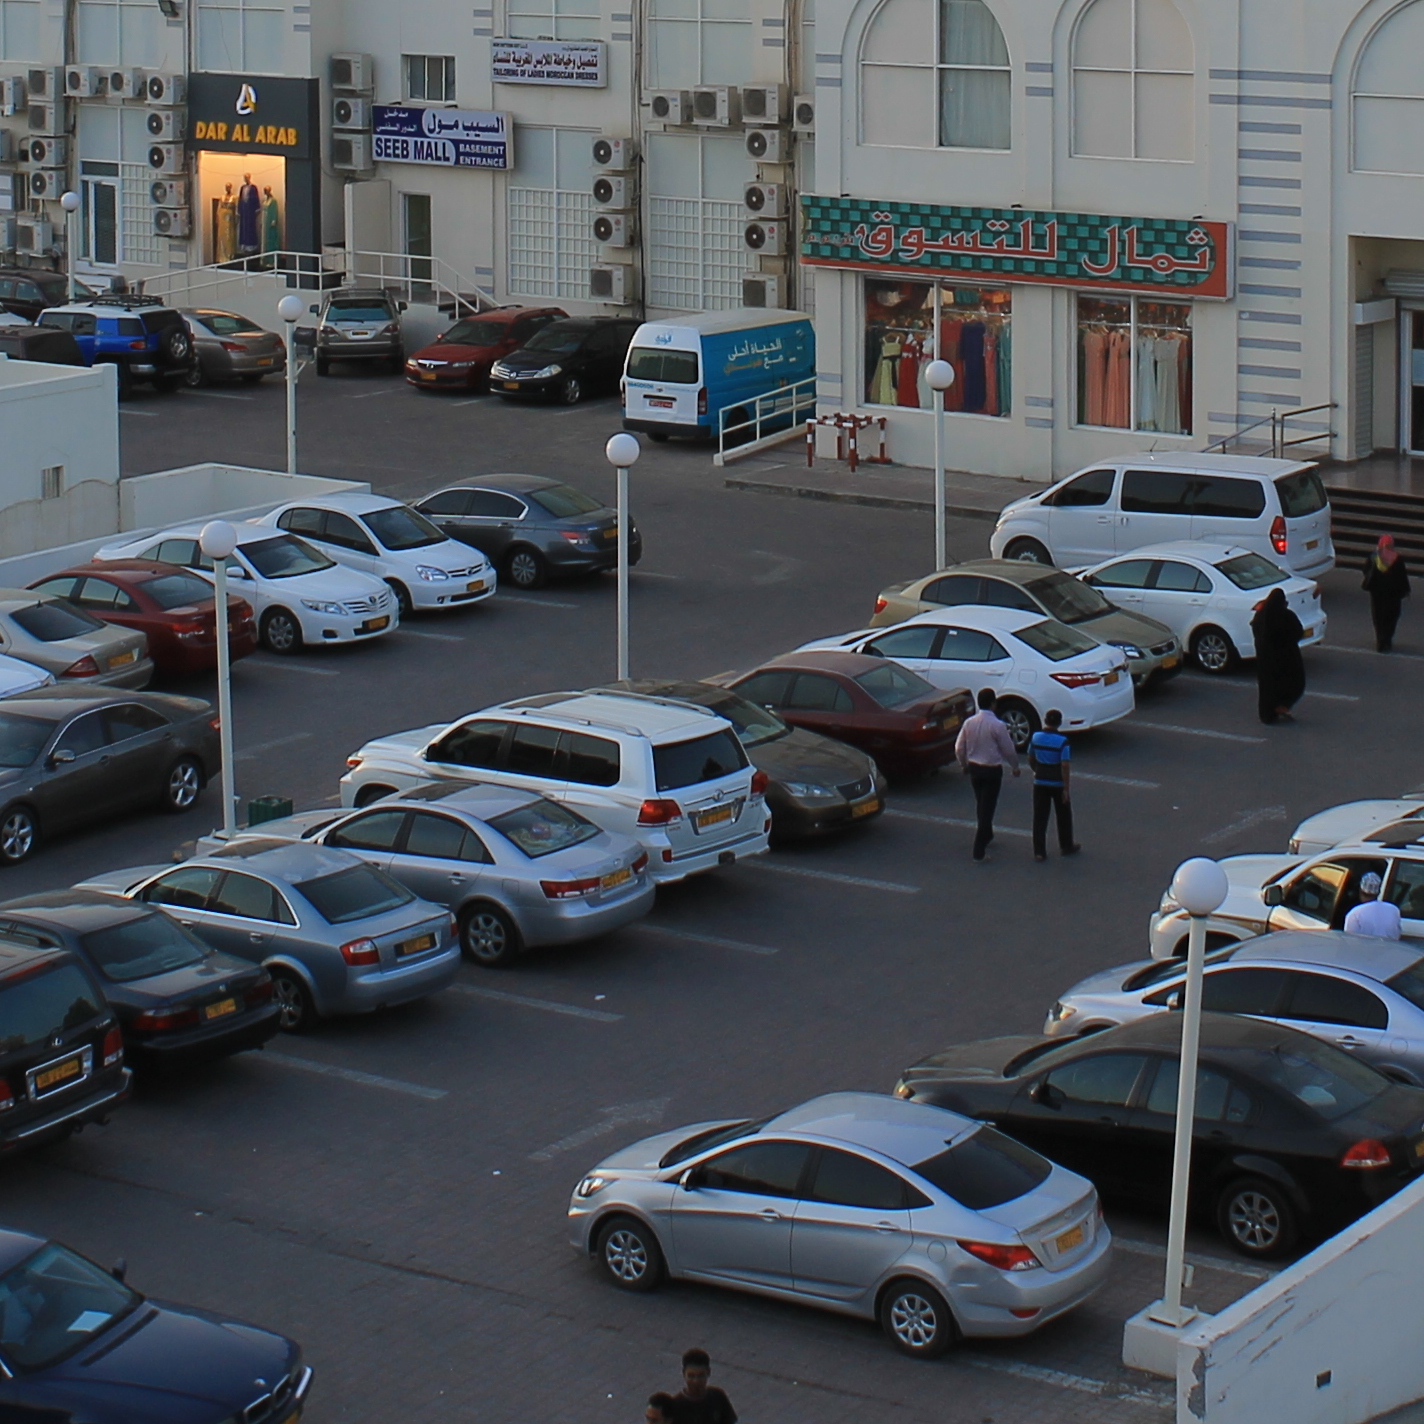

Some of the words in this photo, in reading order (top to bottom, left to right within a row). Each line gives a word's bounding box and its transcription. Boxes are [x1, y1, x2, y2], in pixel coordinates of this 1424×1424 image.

[195, 121, 228, 141] DAR
[231, 124, 251, 142] AL
[255, 125, 298, 145] ARAB
[427, 113, 459, 135] مول
[462, 117, 504, 137] السيب
[375, 138, 409, 159] SEEB
[414, 140, 450, 162] MALL
[459, 144, 504, 154] BASEMENT
[459, 156, 504, 167] ENTRANCE
[854, 211, 1058, 259] للتسوق
[1082, 224, 1209, 276] ثمال
[751, 338, 782, 356] الحياة
[763, 355, 784, 369] مع
